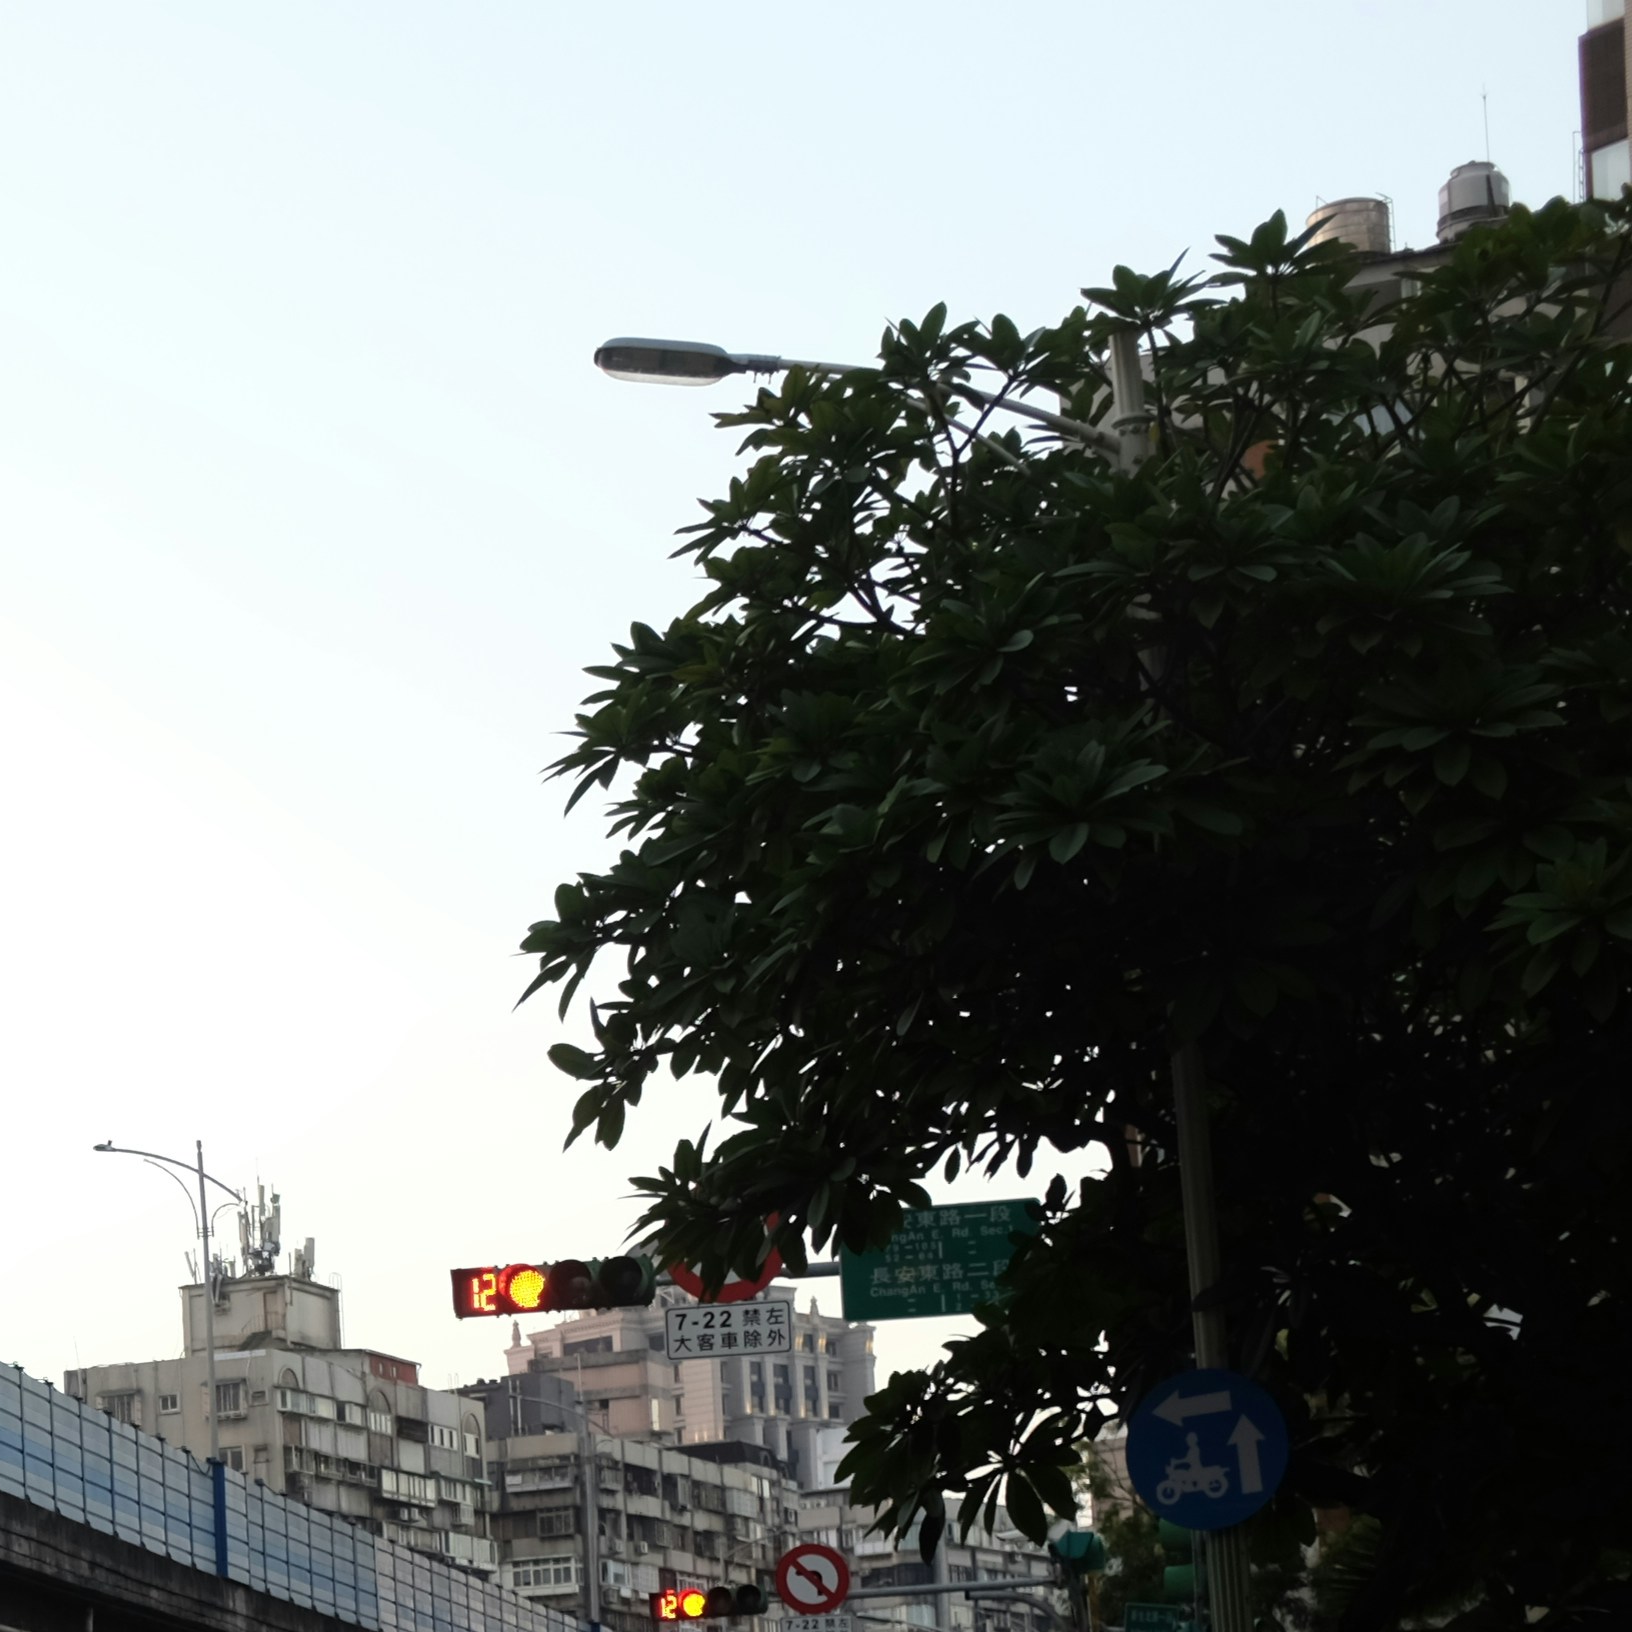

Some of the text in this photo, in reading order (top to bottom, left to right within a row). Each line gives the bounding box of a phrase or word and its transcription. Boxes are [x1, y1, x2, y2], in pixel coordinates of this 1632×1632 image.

[903, 1205, 1012, 1229] 東路一段
[472, 1273, 496, 1311] 12
[870, 1284, 927, 1298] ChangAn
[675, 1308, 785, 1331] 7-22 禁左
[673, 1328, 786, 1353] 大客車除外
[661, 1595, 677, 1619] 12
[786, 1618, 819, 1630] 7-22
